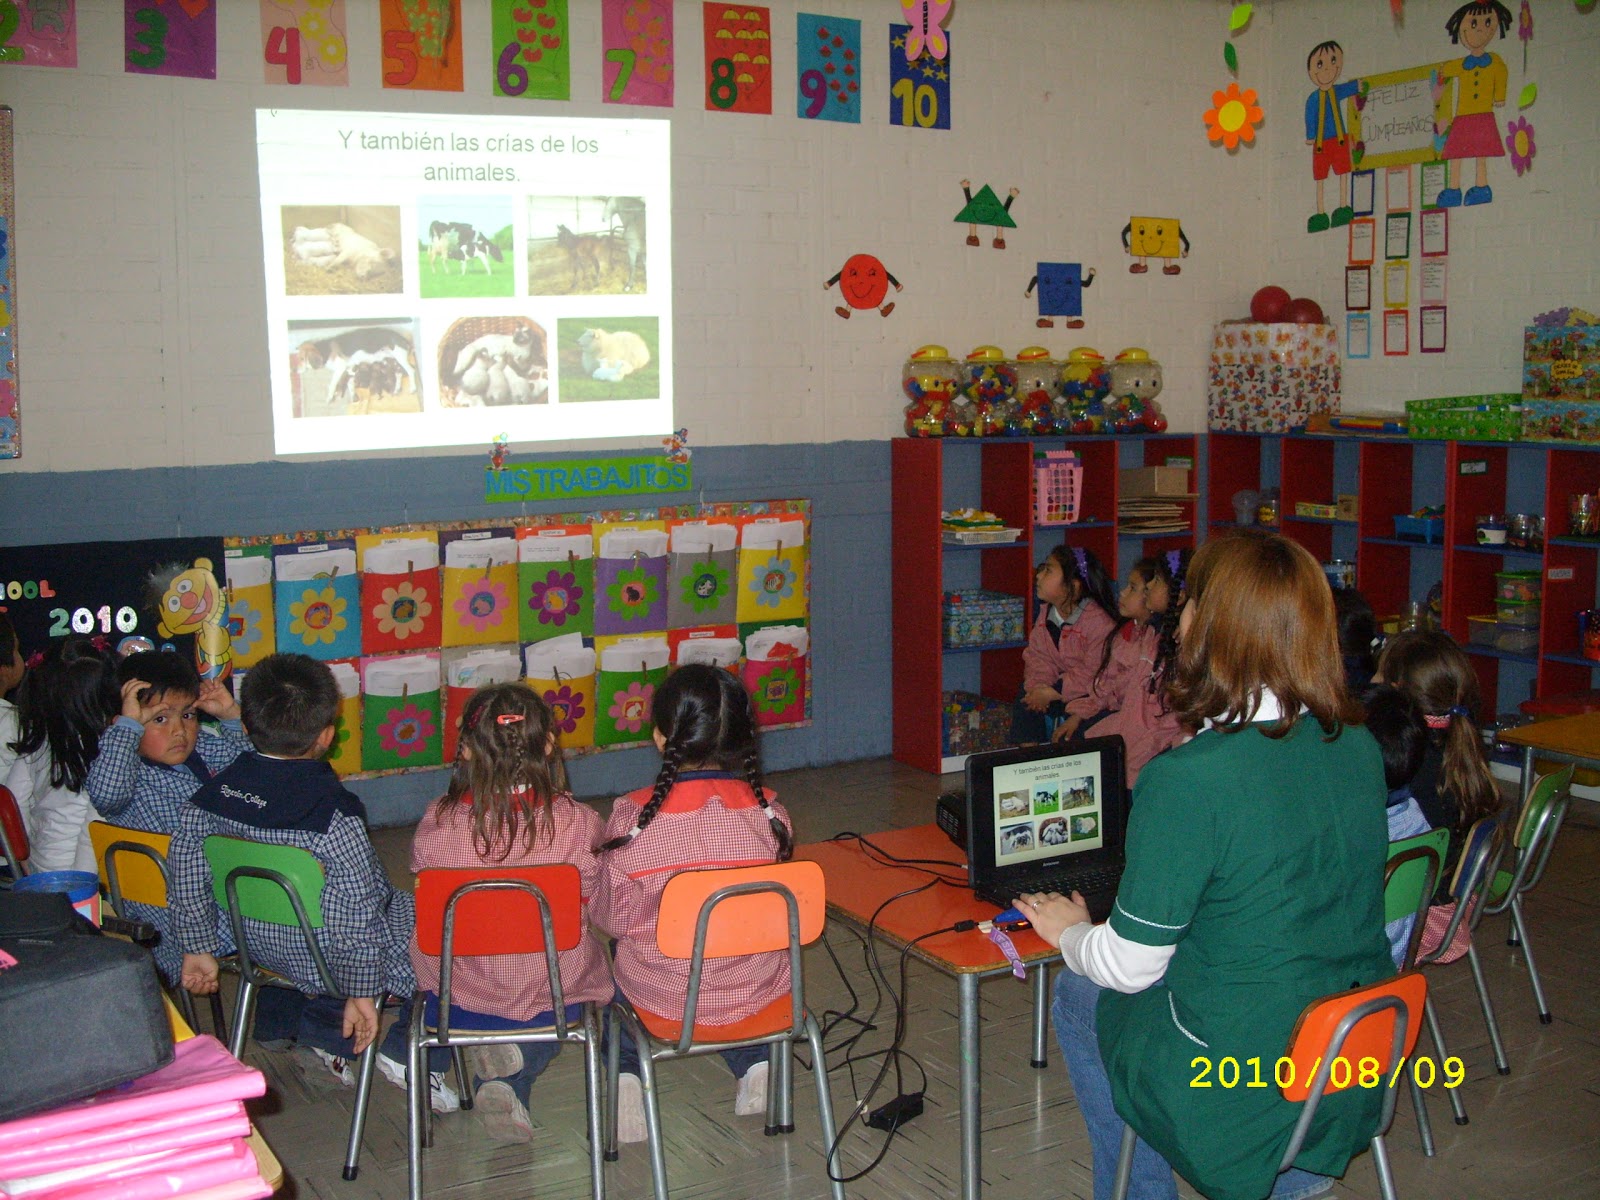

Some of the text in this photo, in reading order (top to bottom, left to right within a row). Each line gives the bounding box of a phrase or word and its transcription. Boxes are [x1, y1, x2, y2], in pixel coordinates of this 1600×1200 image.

[128, 9, 168, 69] 3
[265, 26, 301, 85] 4
[384, 29, 418, 86] 5
[497, 42, 528, 97] 6
[605, 48, 636, 101] 7
[709, 57, 738, 109] 8
[800, 69, 827, 119] 9
[891, 78, 937, 127] 10
[338, 130, 599, 153] Y también las crías de los
[424, 162, 521, 182] animales.
[484, 463, 688, 496] MIS TRABAJITOS
[49, 605, 138, 637] 2010
[244, 792, 267, 809] College
